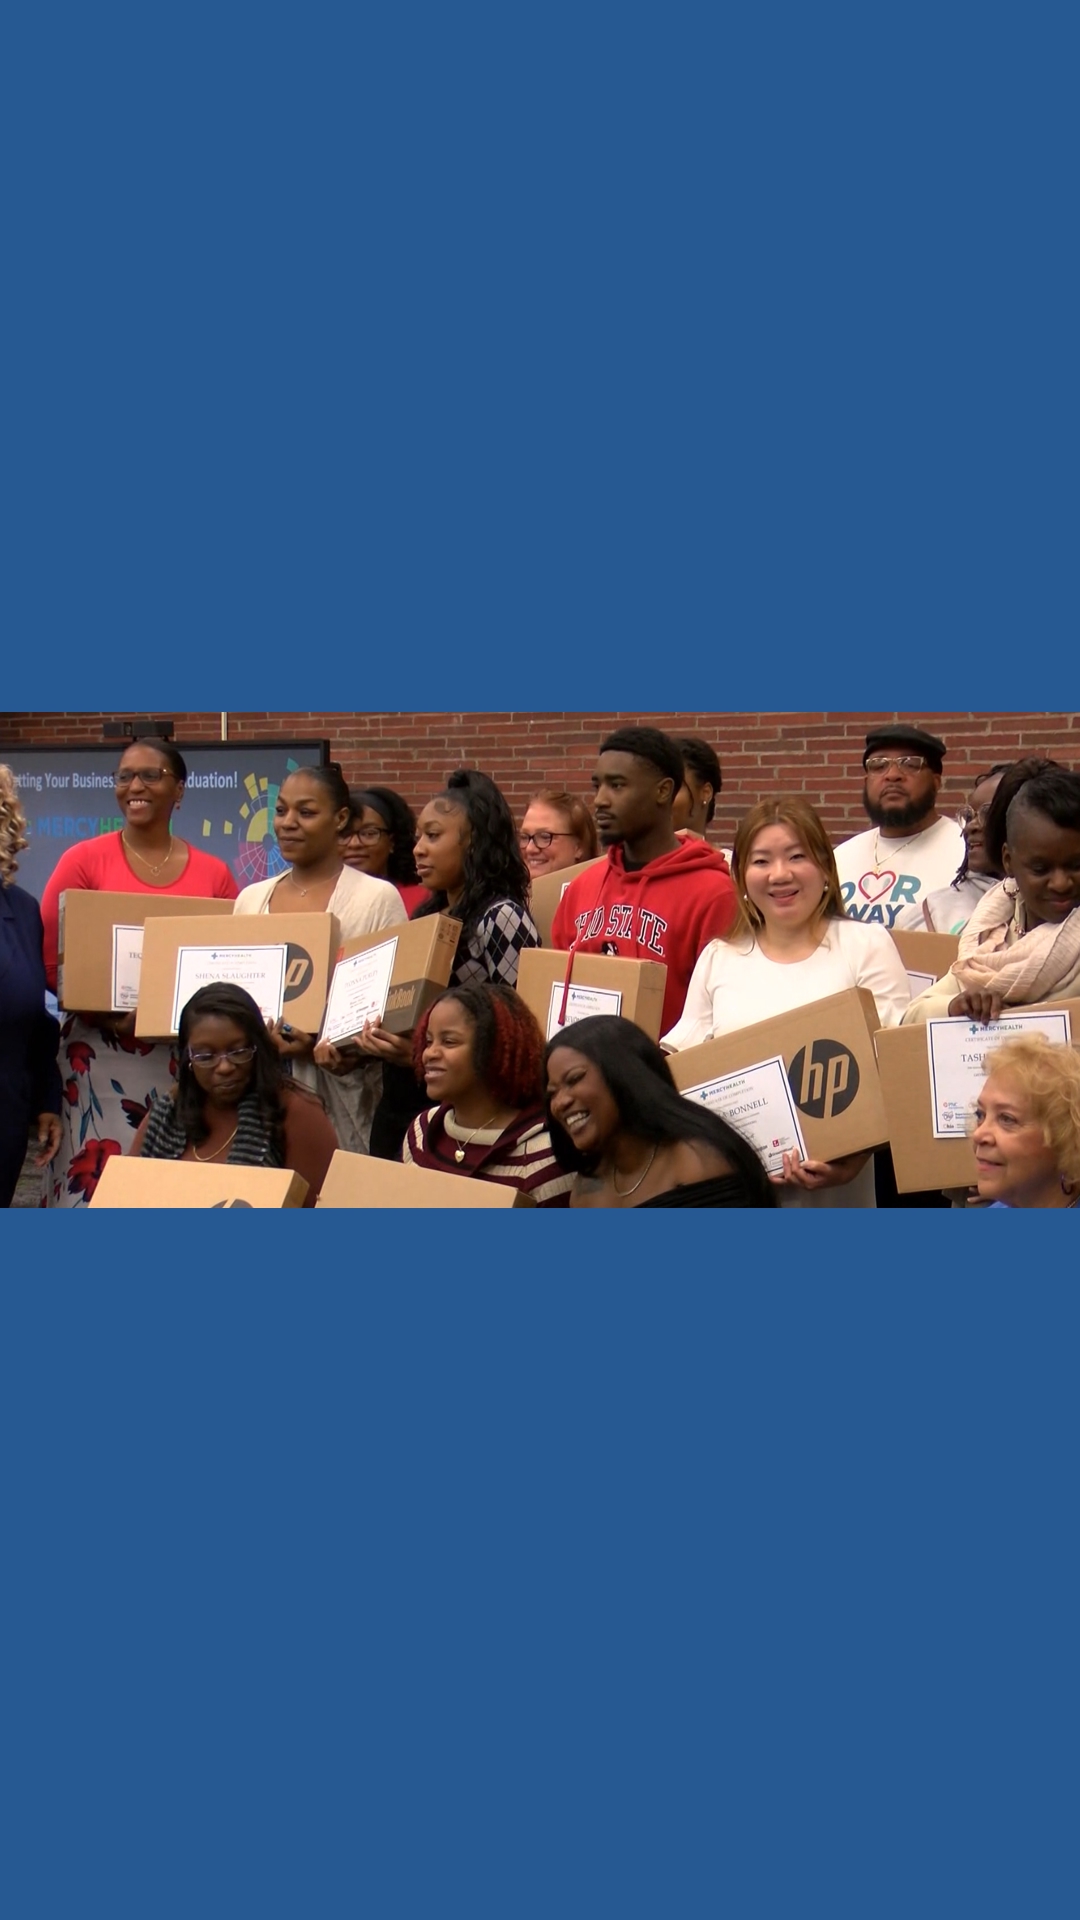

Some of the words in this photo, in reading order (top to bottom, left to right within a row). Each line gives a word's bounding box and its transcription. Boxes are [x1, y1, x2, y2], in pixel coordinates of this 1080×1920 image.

[45, 773, 70, 788] Your
[72, 772, 116, 788] Busines
[184, 771, 238, 788] duation!
[605, 904, 667, 956] STATE
[195, 972, 220, 980] SHENA
[222, 972, 266, 980] SLAUGHTER
[800, 1038, 850, 1118] hp
[709, 1079, 746, 1096] MERCYHEALTH
[729, 1097, 769, 1117] BONNELL
